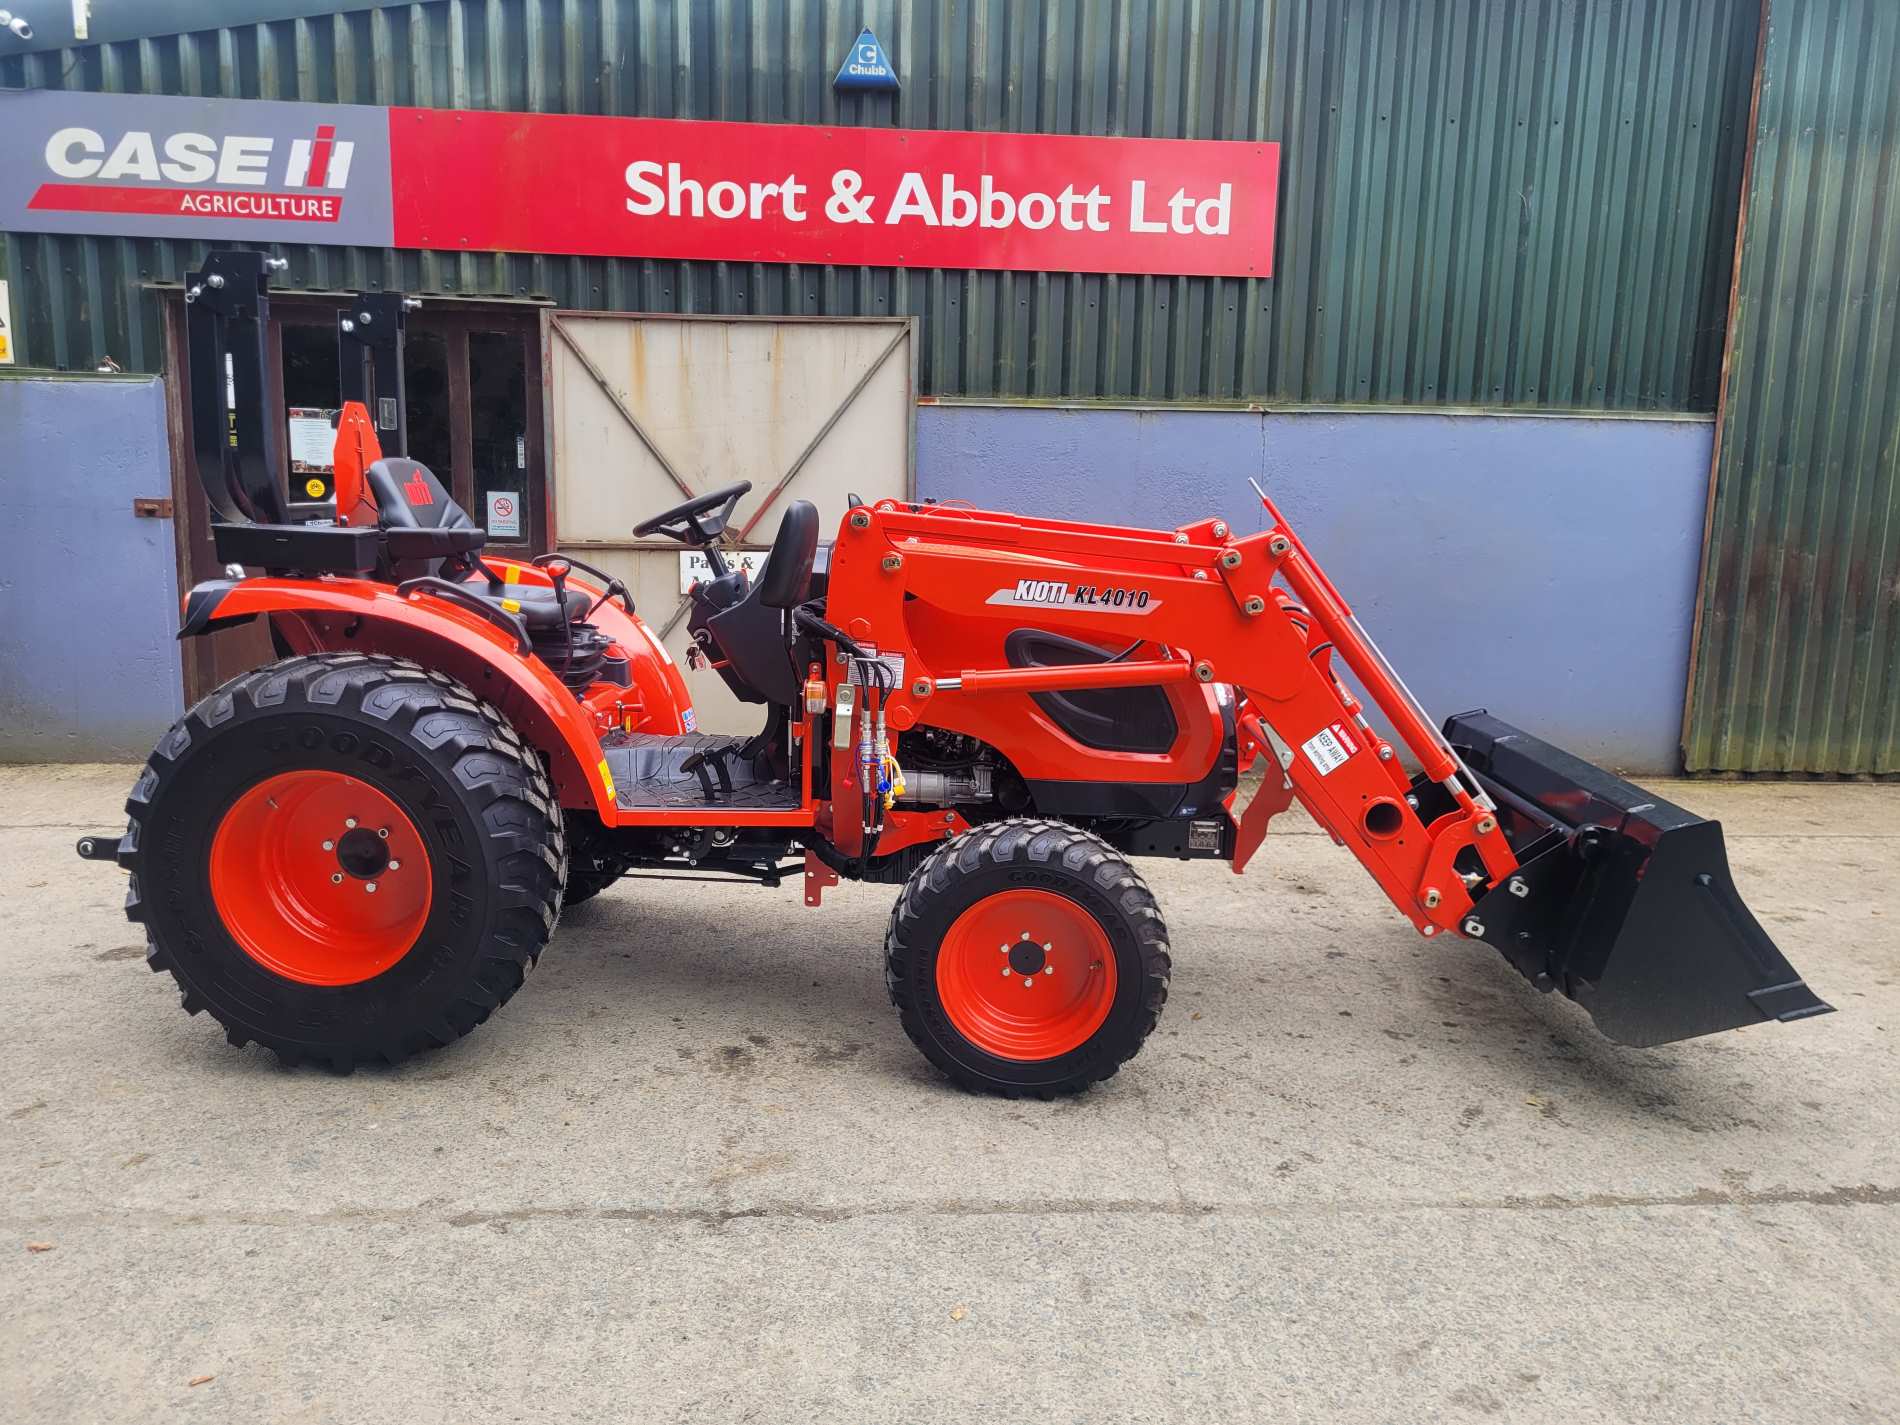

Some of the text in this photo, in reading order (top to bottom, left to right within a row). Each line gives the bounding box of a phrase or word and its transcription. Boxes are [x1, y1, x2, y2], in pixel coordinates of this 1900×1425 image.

[849, 64, 887, 75] Chubb
[46, 128, 273, 186] CASE
[180, 193, 333, 217] AGRICULTURE
[625, 160, 1233, 235] Short & Abbott Ltd
[689, 556, 753, 569] Pas &
[1014, 579, 1149, 608] KIOTI KL4010
[1319, 733, 1345, 763] KEEP AWAY
